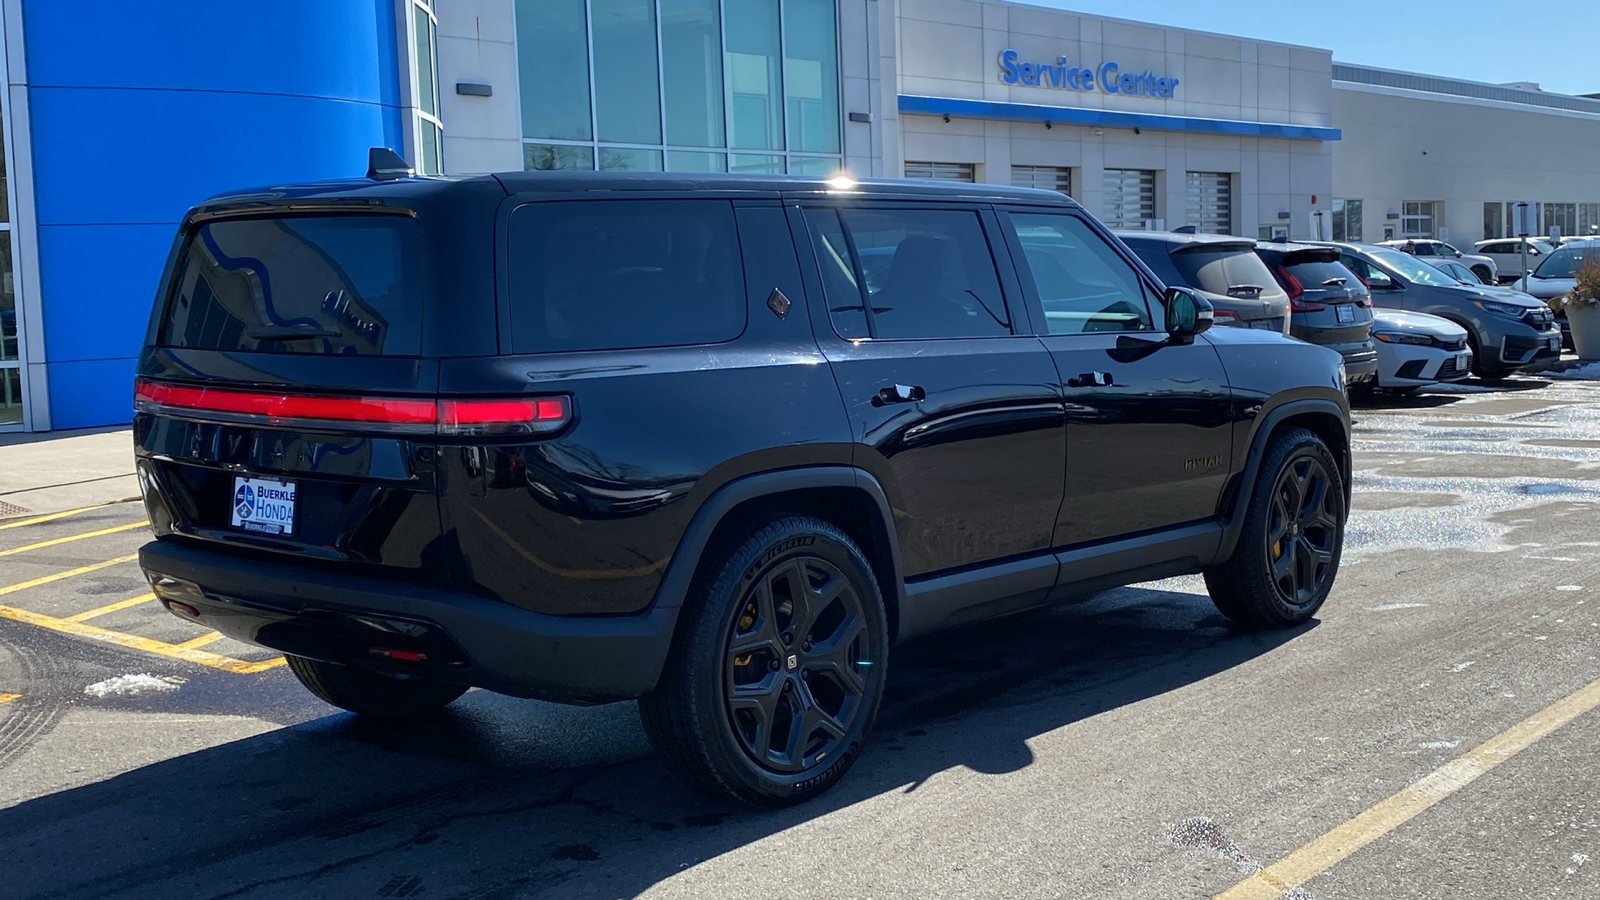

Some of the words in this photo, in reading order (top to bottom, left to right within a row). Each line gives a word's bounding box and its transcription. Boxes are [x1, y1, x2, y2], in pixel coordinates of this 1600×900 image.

[1001, 49, 1094, 92] Service
[1100, 61, 1179, 98] Center
[257, 486, 295, 501] BUERKLE
[256, 499, 292, 521] HONDA
[759, 537, 813, 566] MICHELIN
